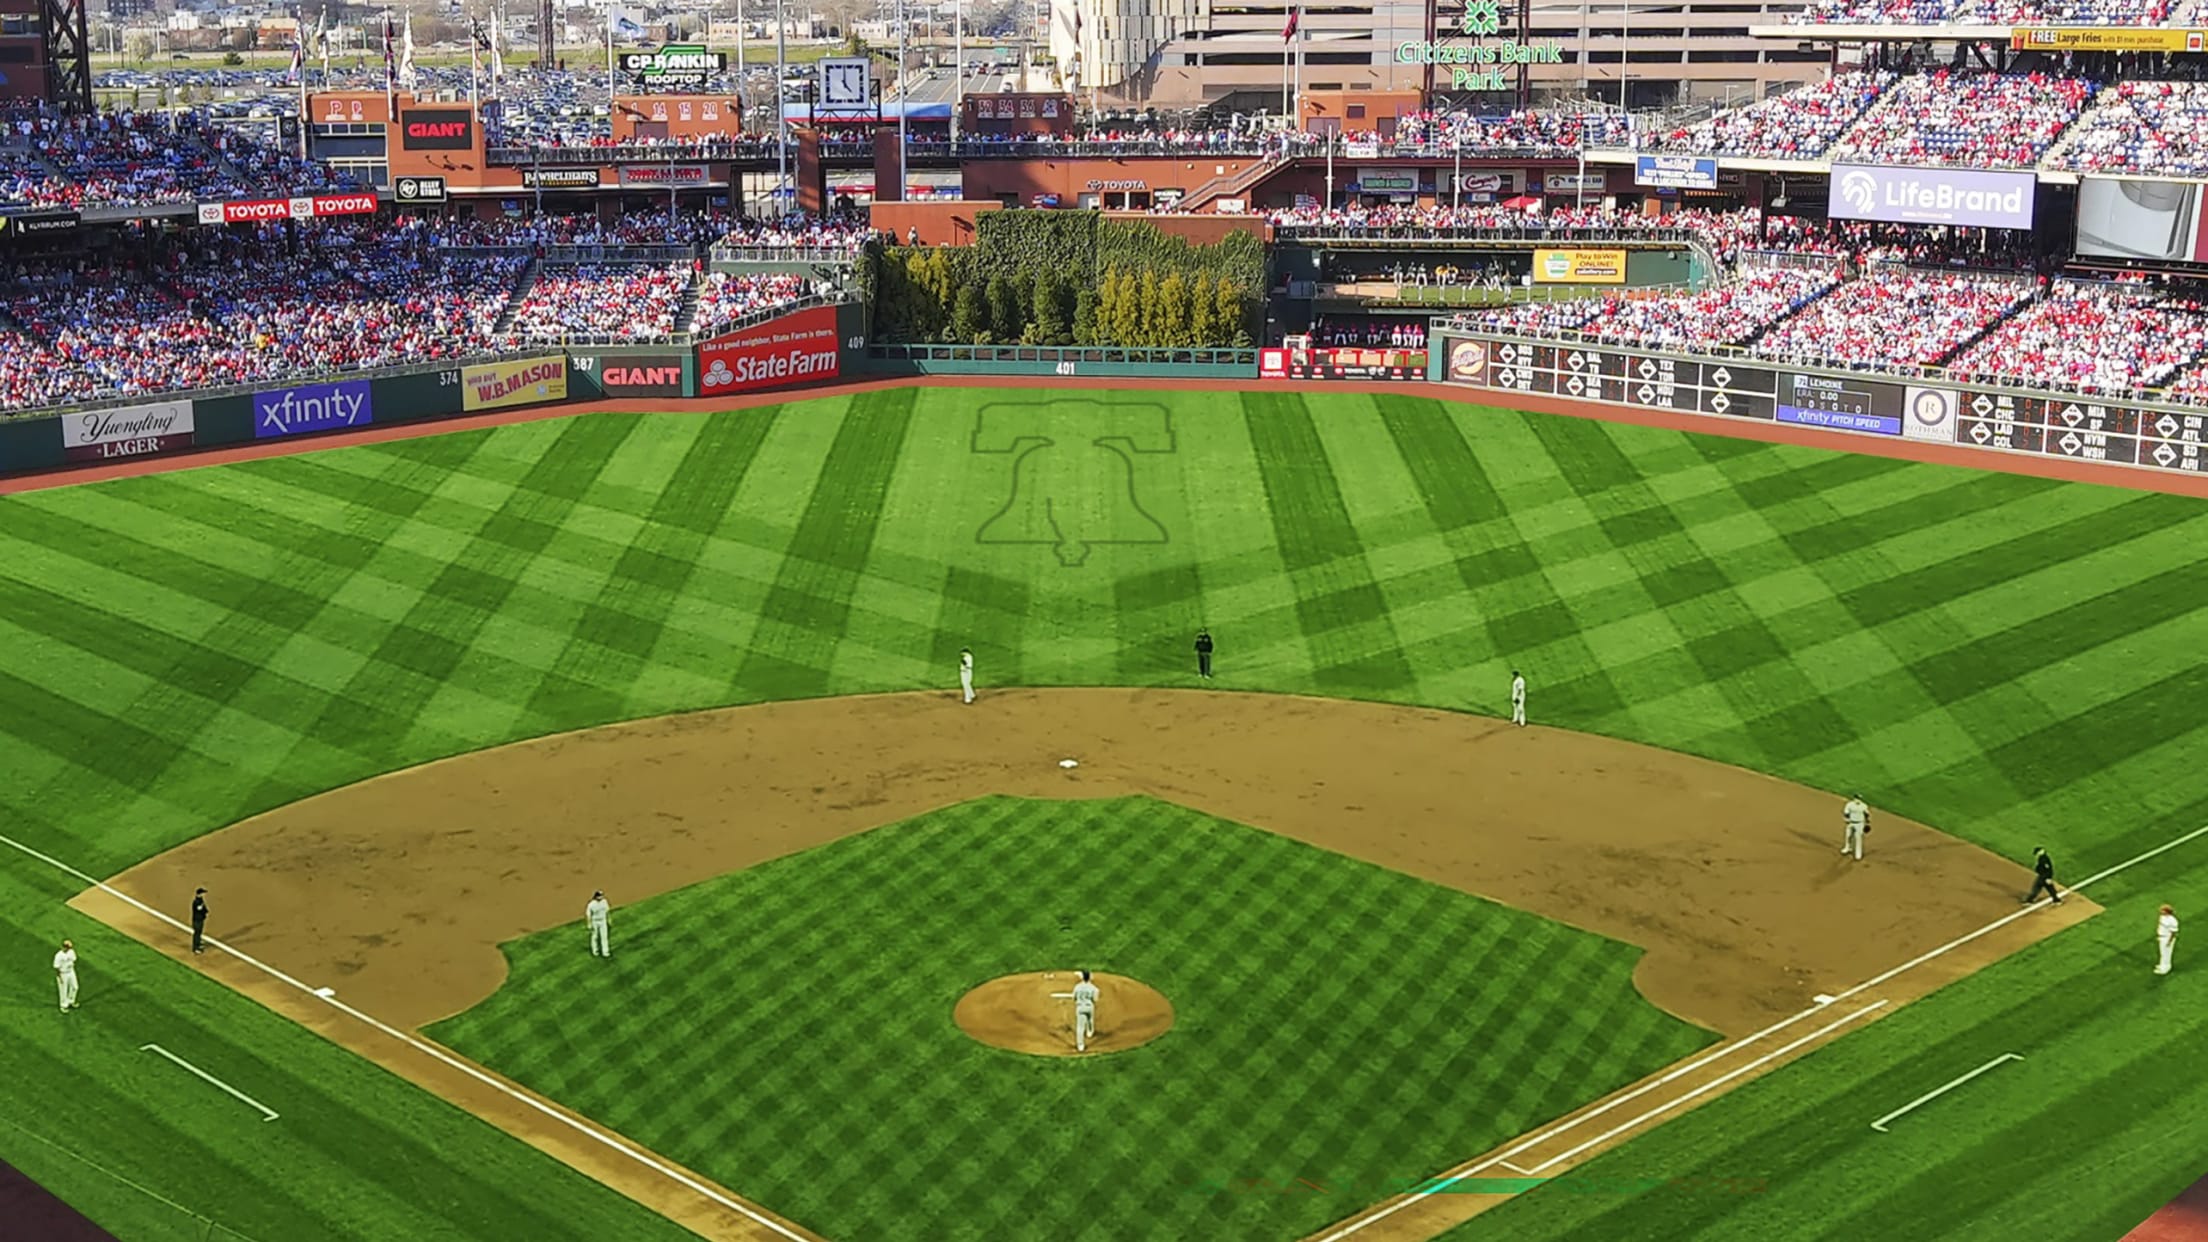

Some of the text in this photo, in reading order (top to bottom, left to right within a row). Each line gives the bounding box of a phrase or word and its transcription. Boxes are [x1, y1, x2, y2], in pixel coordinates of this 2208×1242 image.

[2031, 30, 2056, 44] FREE
[2057, 32, 2081, 45] Large
[1398, 40, 1562, 64] Citizens Bank
[654, 54, 719, 69] RANKIN
[645, 74, 702, 84] ROOFTOP
[1452, 67, 1506, 91] Park
[653, 102, 667, 115] 14
[679, 102, 691, 115] 15
[703, 102, 717, 115] 20
[408, 122, 466, 137] GIANT
[1103, 180, 1146, 190] TOYOTA
[1885, 181, 2022, 213] LifeBrand
[227, 203, 287, 218] TOYOTA
[316, 198, 373, 212] TOYOTA
[1576, 252, 1592, 260] Play
[1602, 252, 1618, 260] Win
[1580, 260, 1614, 268] ONLINE!
[702, 343, 717, 351] Like
[723, 341, 740, 350] good
[741, 337, 772, 348] neighbor,
[773, 334, 790, 343] State
[791, 331, 808, 340] Farm
[815, 329, 834, 337] there.
[848, 336, 865, 349] 409
[573, 357, 594, 371] 387
[1056, 361, 1075, 375] 401
[1660, 360, 1675, 371] TEX
[440, 371, 458, 386] 374
[602, 367, 681, 385] GIANT
[1820, 391, 1839, 401] 0.00
[263, 388, 364, 432] xfinity
[1925, 401, 1936, 414] R
[1995, 408, 2015, 421] CHC
[2087, 405, 2106, 418] MIA
[80, 408, 178, 442] Yuengling
[1797, 409, 1881, 429] xfinity PITCH SPEED
[1993, 436, 2013, 449] COL
[2181, 429, 2200, 442] ATL
[103, 437, 159, 457] LAGER
[2082, 446, 2106, 459] WSH
[2180, 458, 2199, 471] ARI
